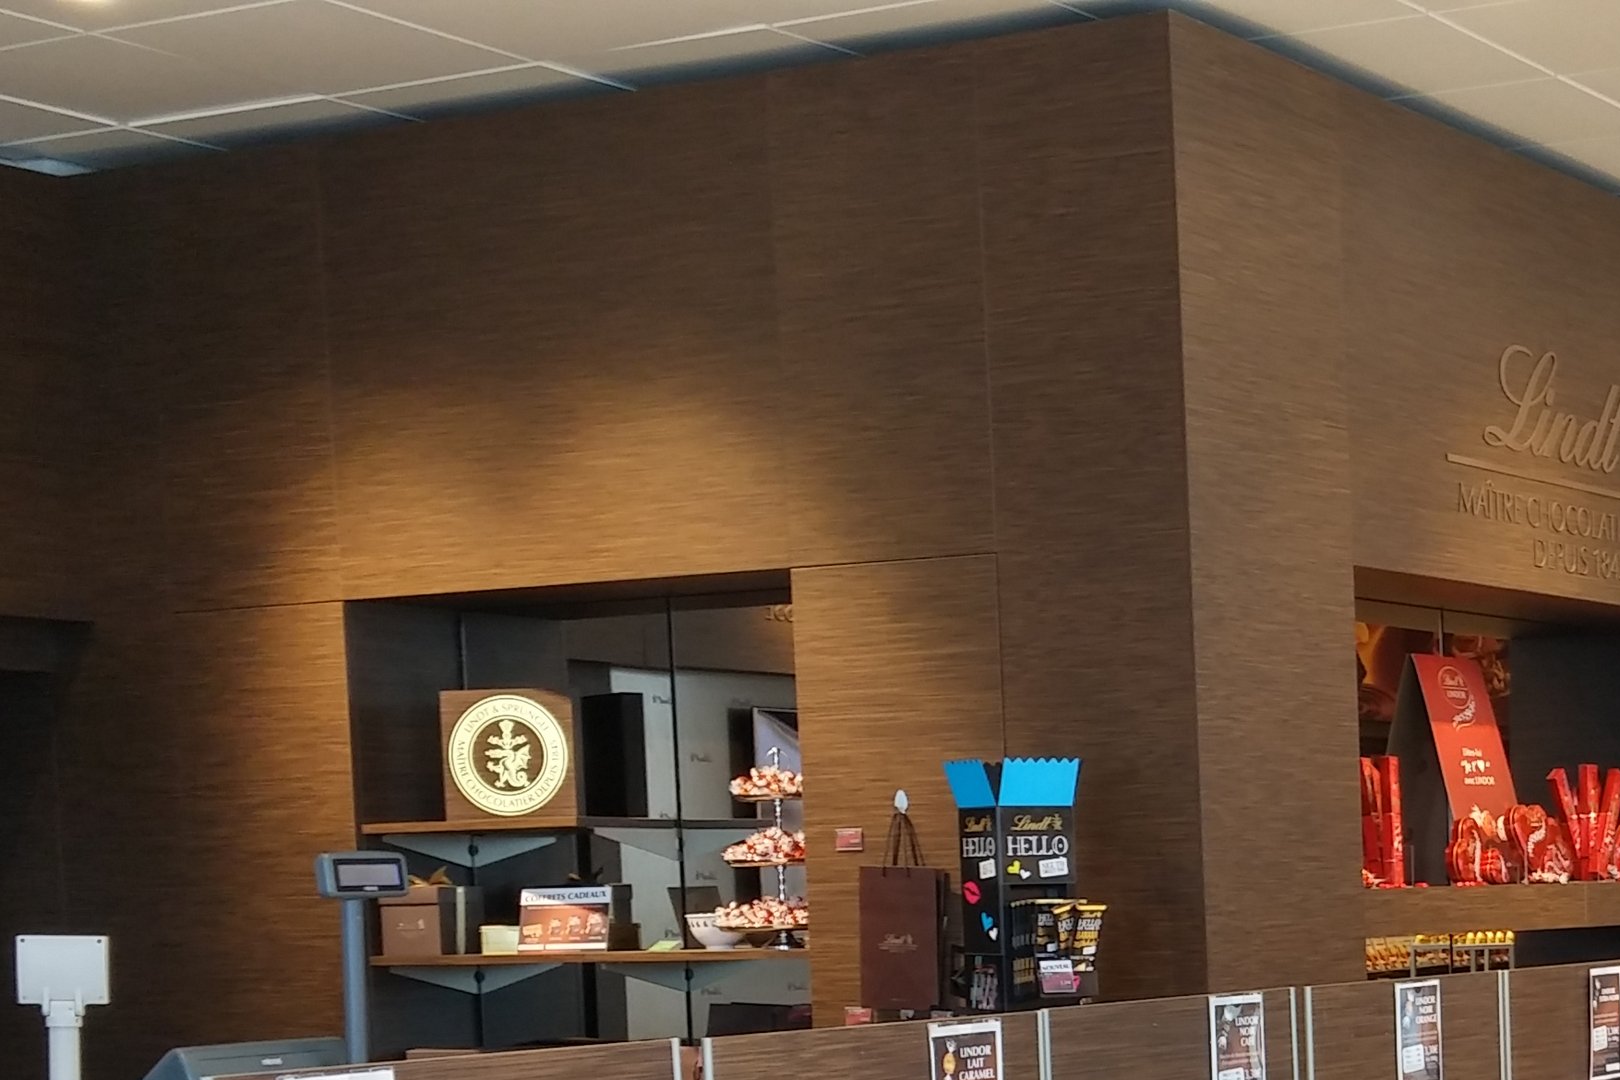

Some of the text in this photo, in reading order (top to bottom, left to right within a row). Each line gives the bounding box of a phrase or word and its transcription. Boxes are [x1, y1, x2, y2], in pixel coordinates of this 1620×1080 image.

[1457, 480, 1520, 526] MAÎTRE
[1533, 538, 1590, 577] DEPUIS
[1010, 815, 1051, 831] Lindt
[961, 836, 996, 858] HELLO
[1006, 835, 1069, 856] HELLO
[567, 890, 607, 900] CADEAUX
[960, 1044, 992, 1058] LINDOR
[967, 1057, 985, 1070] LAIT
